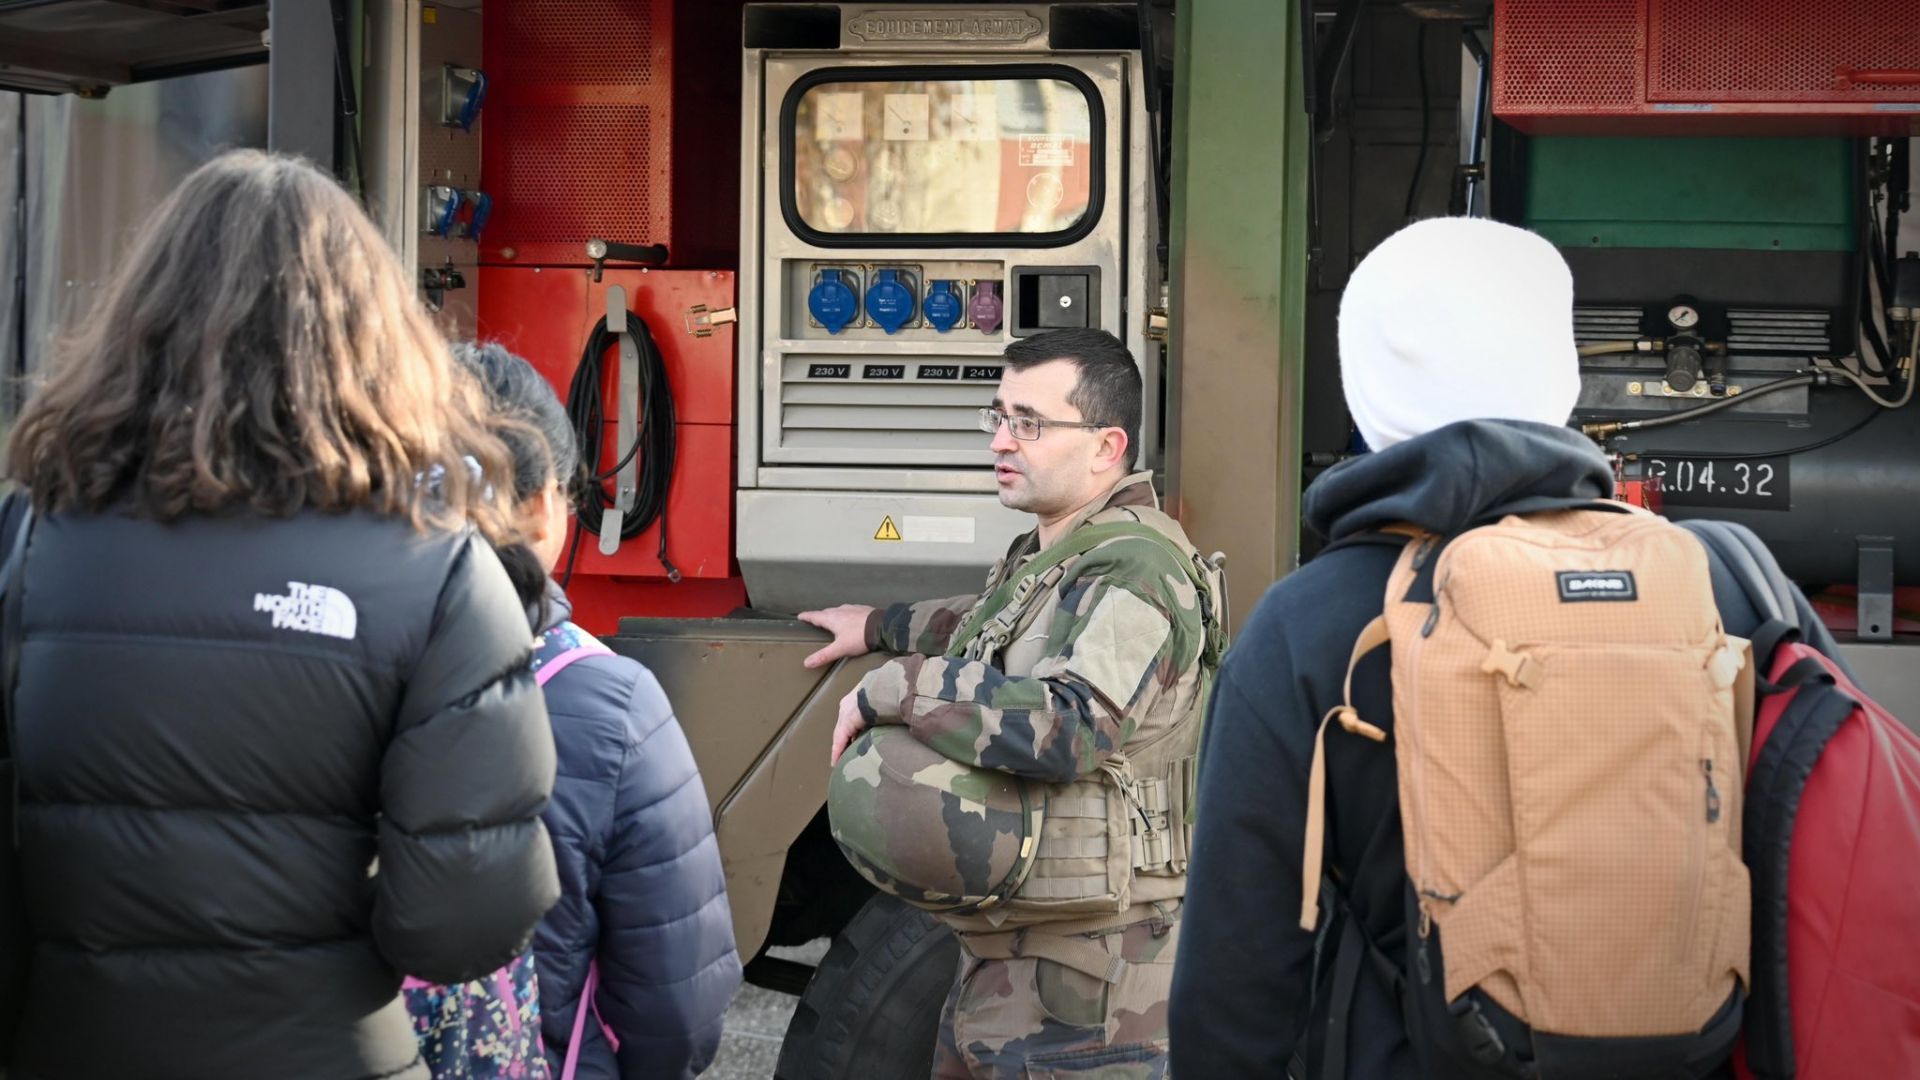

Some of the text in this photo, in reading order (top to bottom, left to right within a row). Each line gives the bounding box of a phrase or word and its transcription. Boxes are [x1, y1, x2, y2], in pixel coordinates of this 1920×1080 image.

[865, 19, 963, 34] EQUIPEMENT
[814, 367, 846, 376] 230 V
[869, 368, 900, 377] 230 V
[923, 368, 954, 377] 230 V
[970, 368, 996, 378] 24 V
[287, 581, 325, 602] THE
[253, 593, 323, 617] NORTH
[272, 609, 322, 634] FACE
